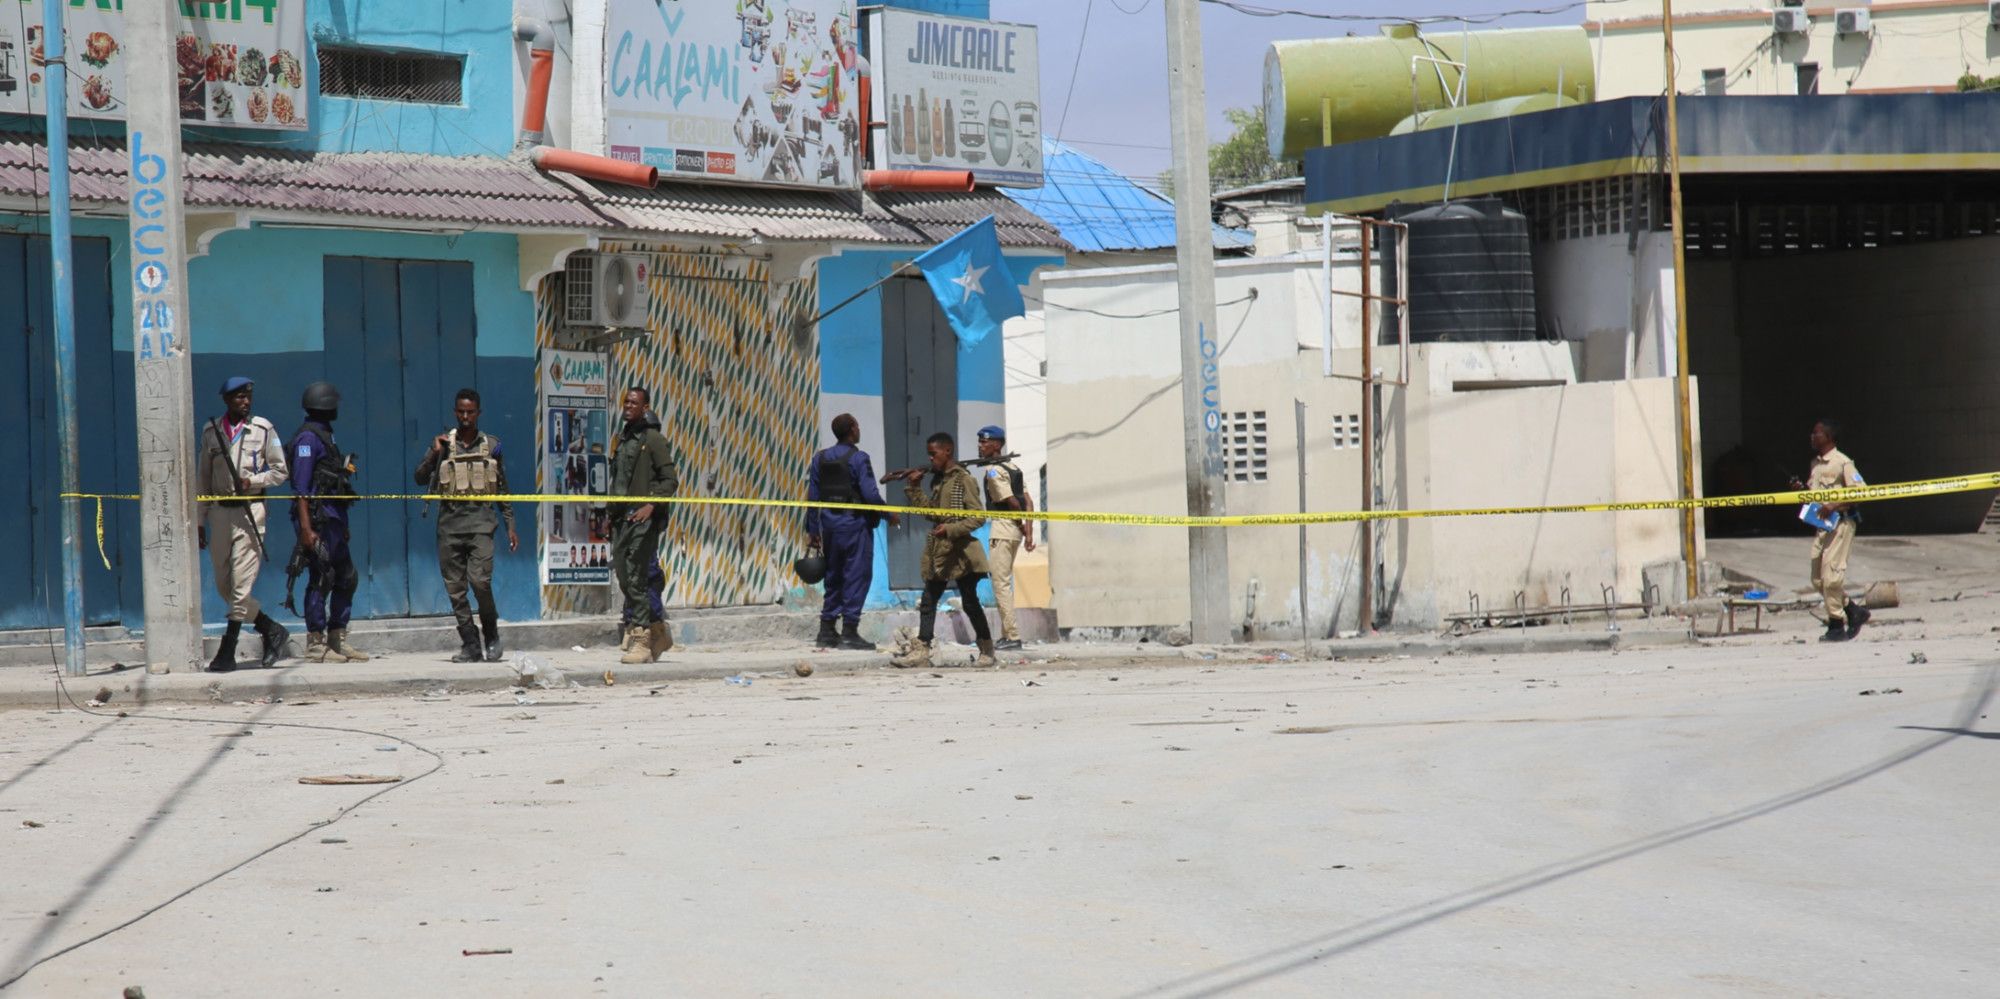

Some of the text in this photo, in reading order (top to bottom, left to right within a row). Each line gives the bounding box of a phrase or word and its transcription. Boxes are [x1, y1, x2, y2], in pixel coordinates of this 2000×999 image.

[907, 20, 1017, 74] JIMCAALE
[612, 151, 640, 164] TRAVEL
[1797, 490, 1840, 503] CROSS
[1841, 488, 1867, 501] NOT
[1868, 486, 1887, 498] DO
[1695, 498, 1737, 509] SCENE
[1738, 495, 1777, 506] CRIME
